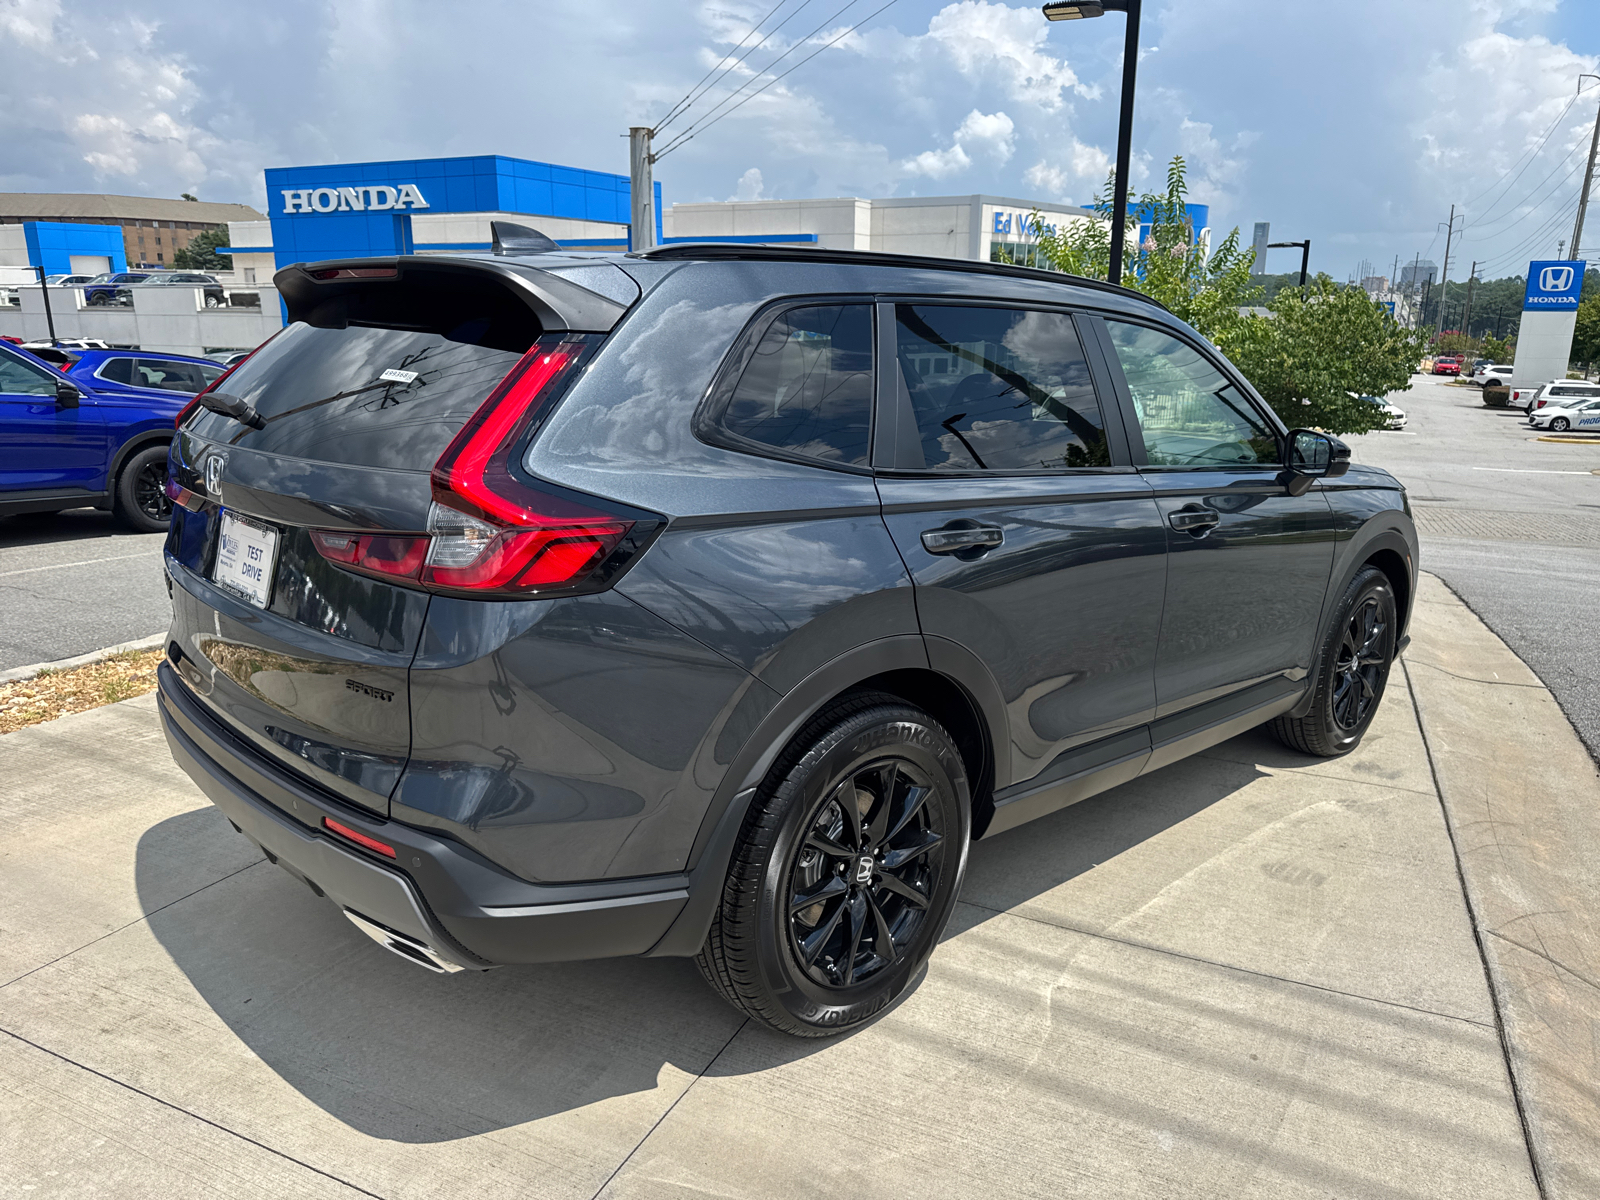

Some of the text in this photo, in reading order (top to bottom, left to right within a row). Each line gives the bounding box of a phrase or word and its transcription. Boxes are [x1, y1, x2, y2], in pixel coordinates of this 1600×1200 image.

[281, 184, 430, 214] HONDA
[994, 212, 1012, 234] Ed
[247, 544, 264, 562] TEST
[241, 561, 263, 582] DRIVE
[345, 678, 395, 703] SPORT
[816, 988, 891, 1027] KINERGY
